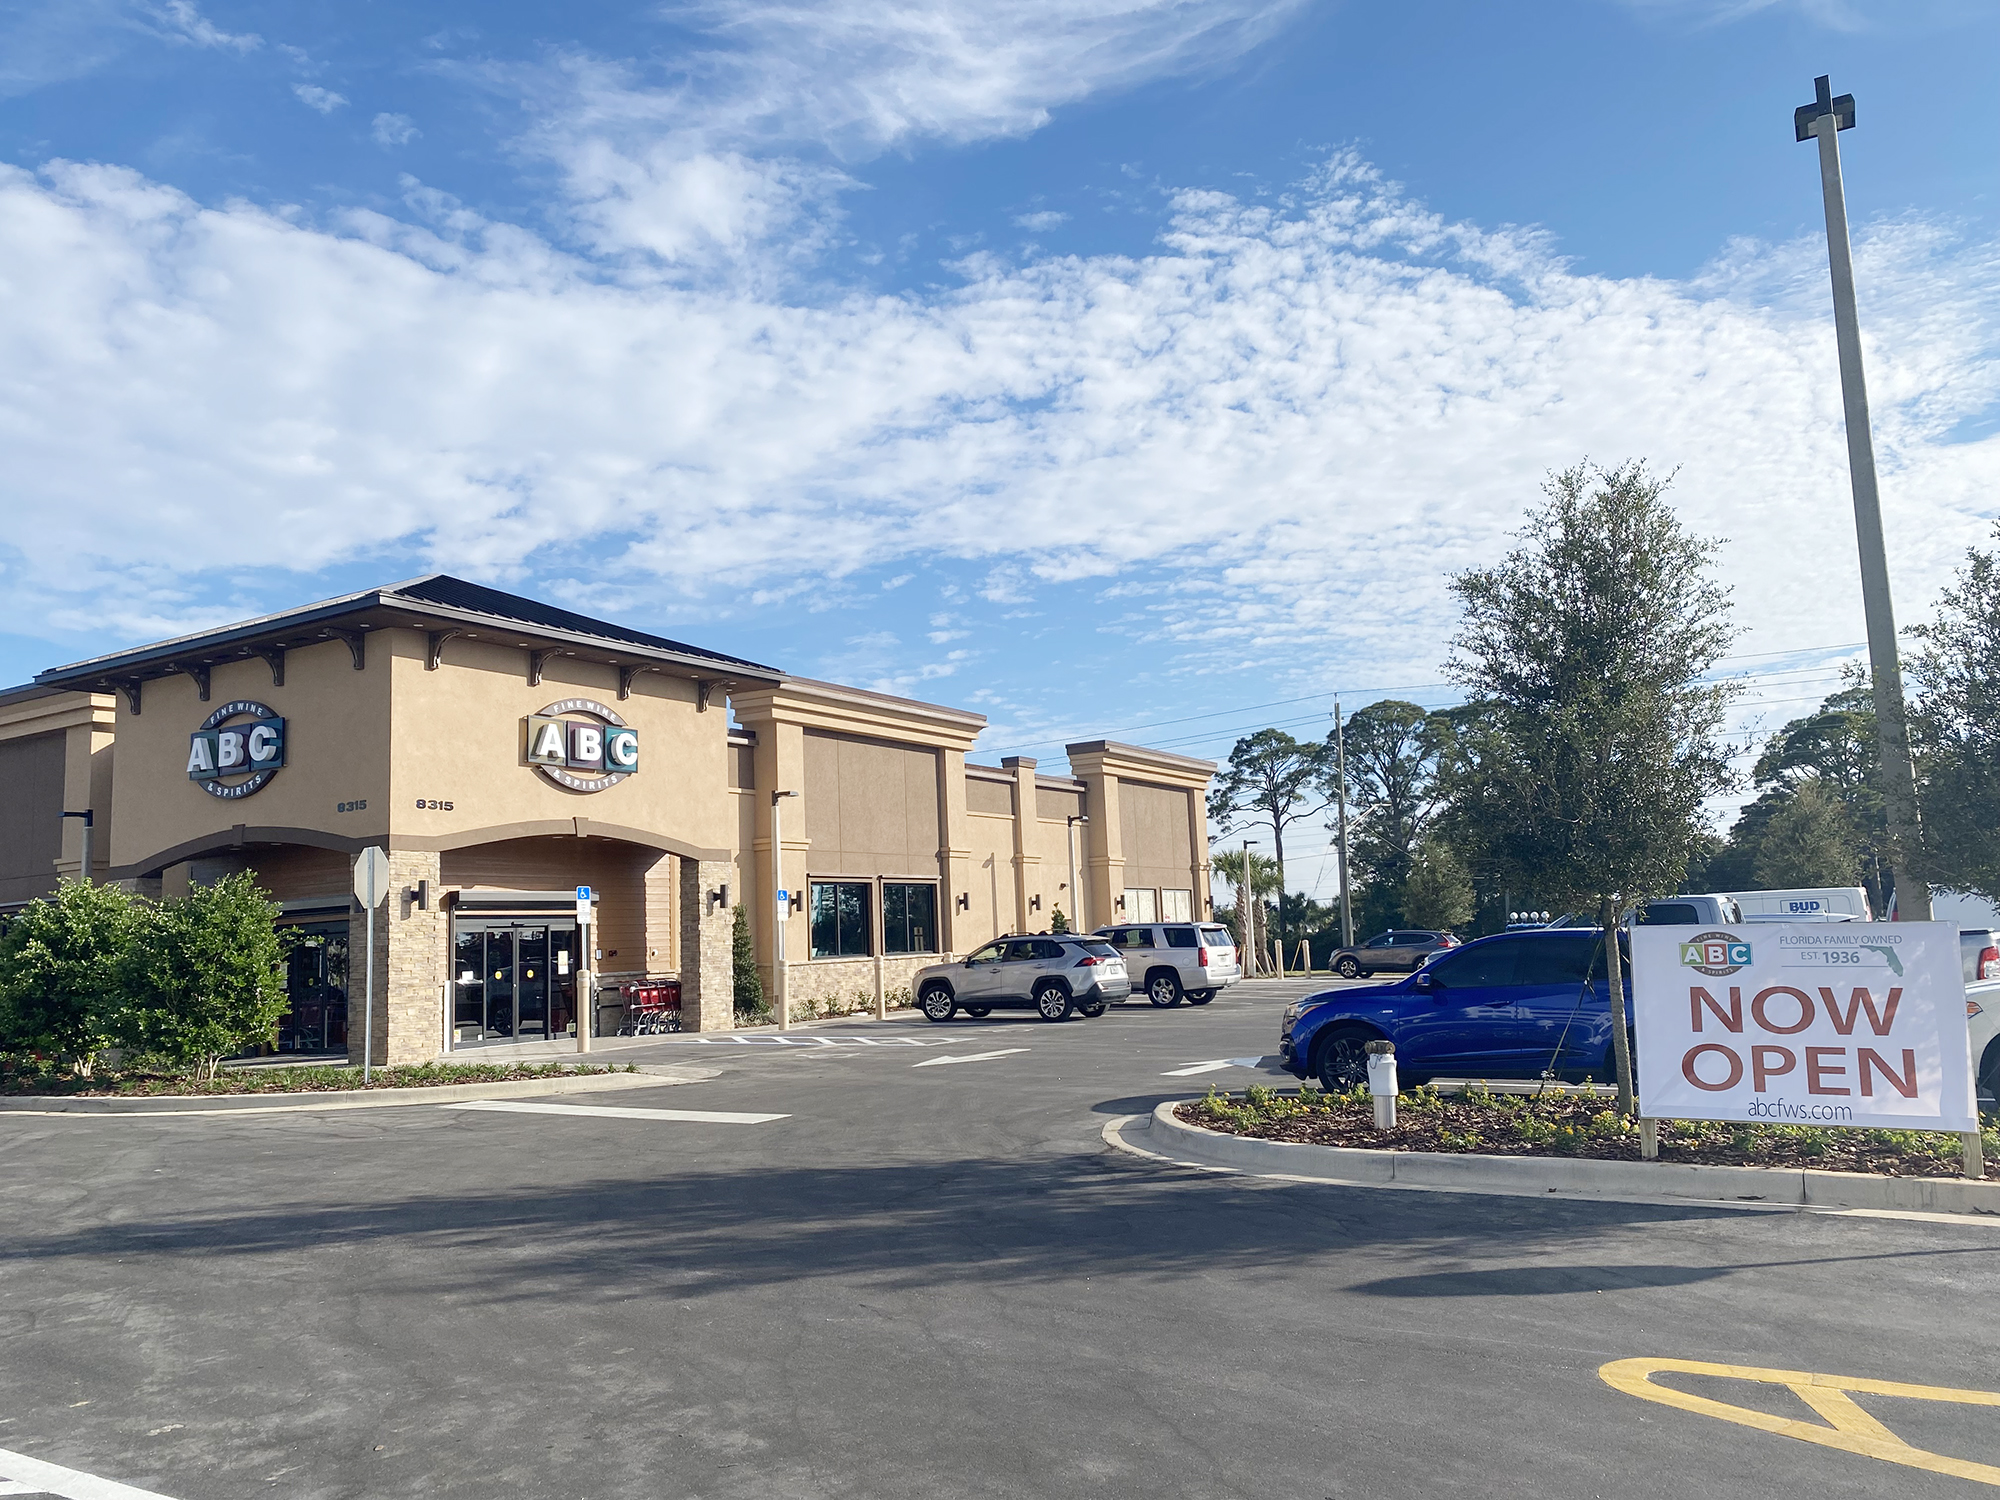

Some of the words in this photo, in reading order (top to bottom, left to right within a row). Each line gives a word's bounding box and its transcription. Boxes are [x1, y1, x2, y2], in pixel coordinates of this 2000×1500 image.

[210, 704, 234, 724] FINE
[237, 702, 263, 716] WINE
[553, 700, 582, 713] FINE
[586, 701, 617, 721] WINE
[187, 726, 277, 772] ABC
[535, 723, 638, 765] ABC
[207, 782, 213, 792] &
[216, 774, 261, 796] SPIRITS
[553, 769, 560, 779] &
[564, 775, 618, 790] SPIRITS
[337, 800, 367, 813] 8315
[416, 799, 454, 811] 8315
[1789, 901, 1820, 912] BUD
[1696, 933, 1712, 942] FINE
[1715, 933, 1733, 941] WINE
[1779, 935, 1822, 945] FLORIDA
[1824, 935, 1860, 945] FAMILY
[1861, 935, 1903, 945] OWNED
[1684, 946, 1748, 963] ABC
[1801, 951, 1820, 960] EST.
[1822, 951, 1861, 964] 1936
[1690, 986, 1903, 1036] NOW
[1682, 1043, 1919, 1099] OPEN
[1748, 1097, 1853, 1121] abcfws.com
